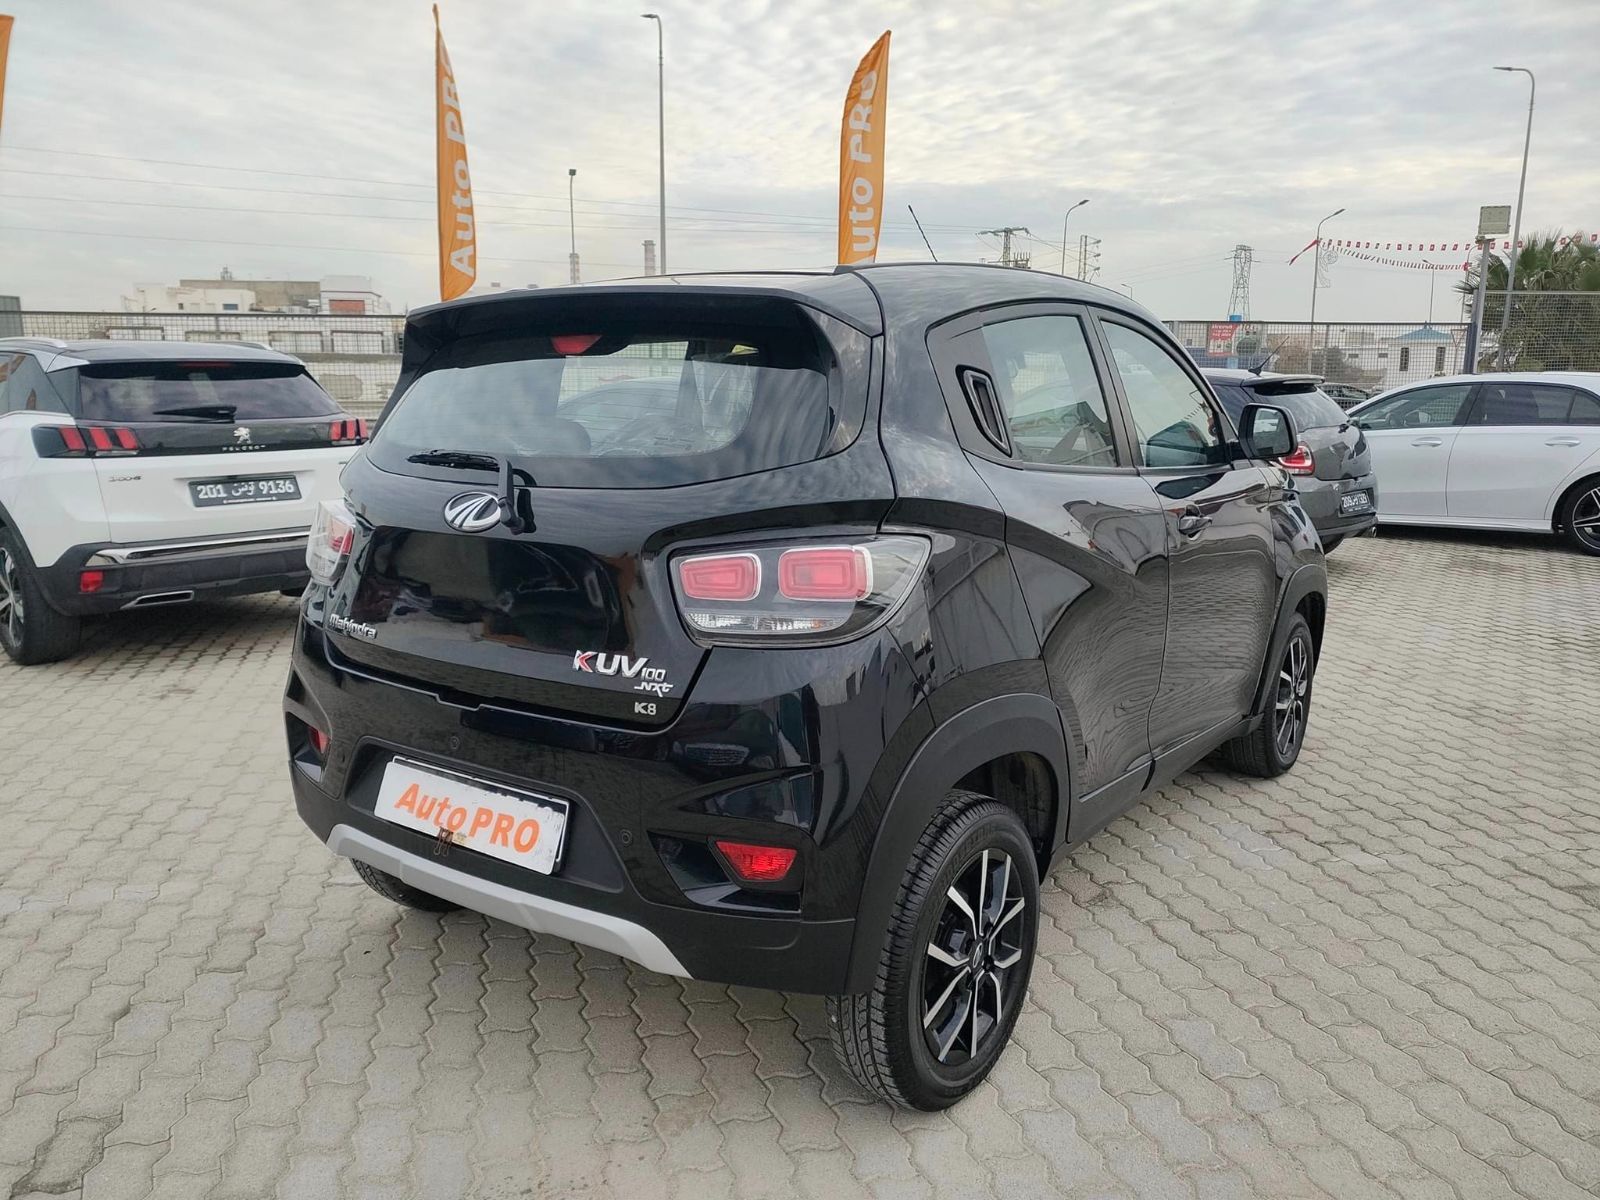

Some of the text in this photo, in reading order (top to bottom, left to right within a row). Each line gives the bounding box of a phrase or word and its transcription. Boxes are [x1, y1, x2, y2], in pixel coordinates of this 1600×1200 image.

[450, 159, 475, 278] Auto
[848, 176, 877, 264] uto
[197, 484, 227, 499] 201
[258, 480, 294, 494] 9136
[330, 613, 377, 639] Mahindra
[634, 702, 657, 715] K8
[393, 783, 540, 854] Auto PRO
